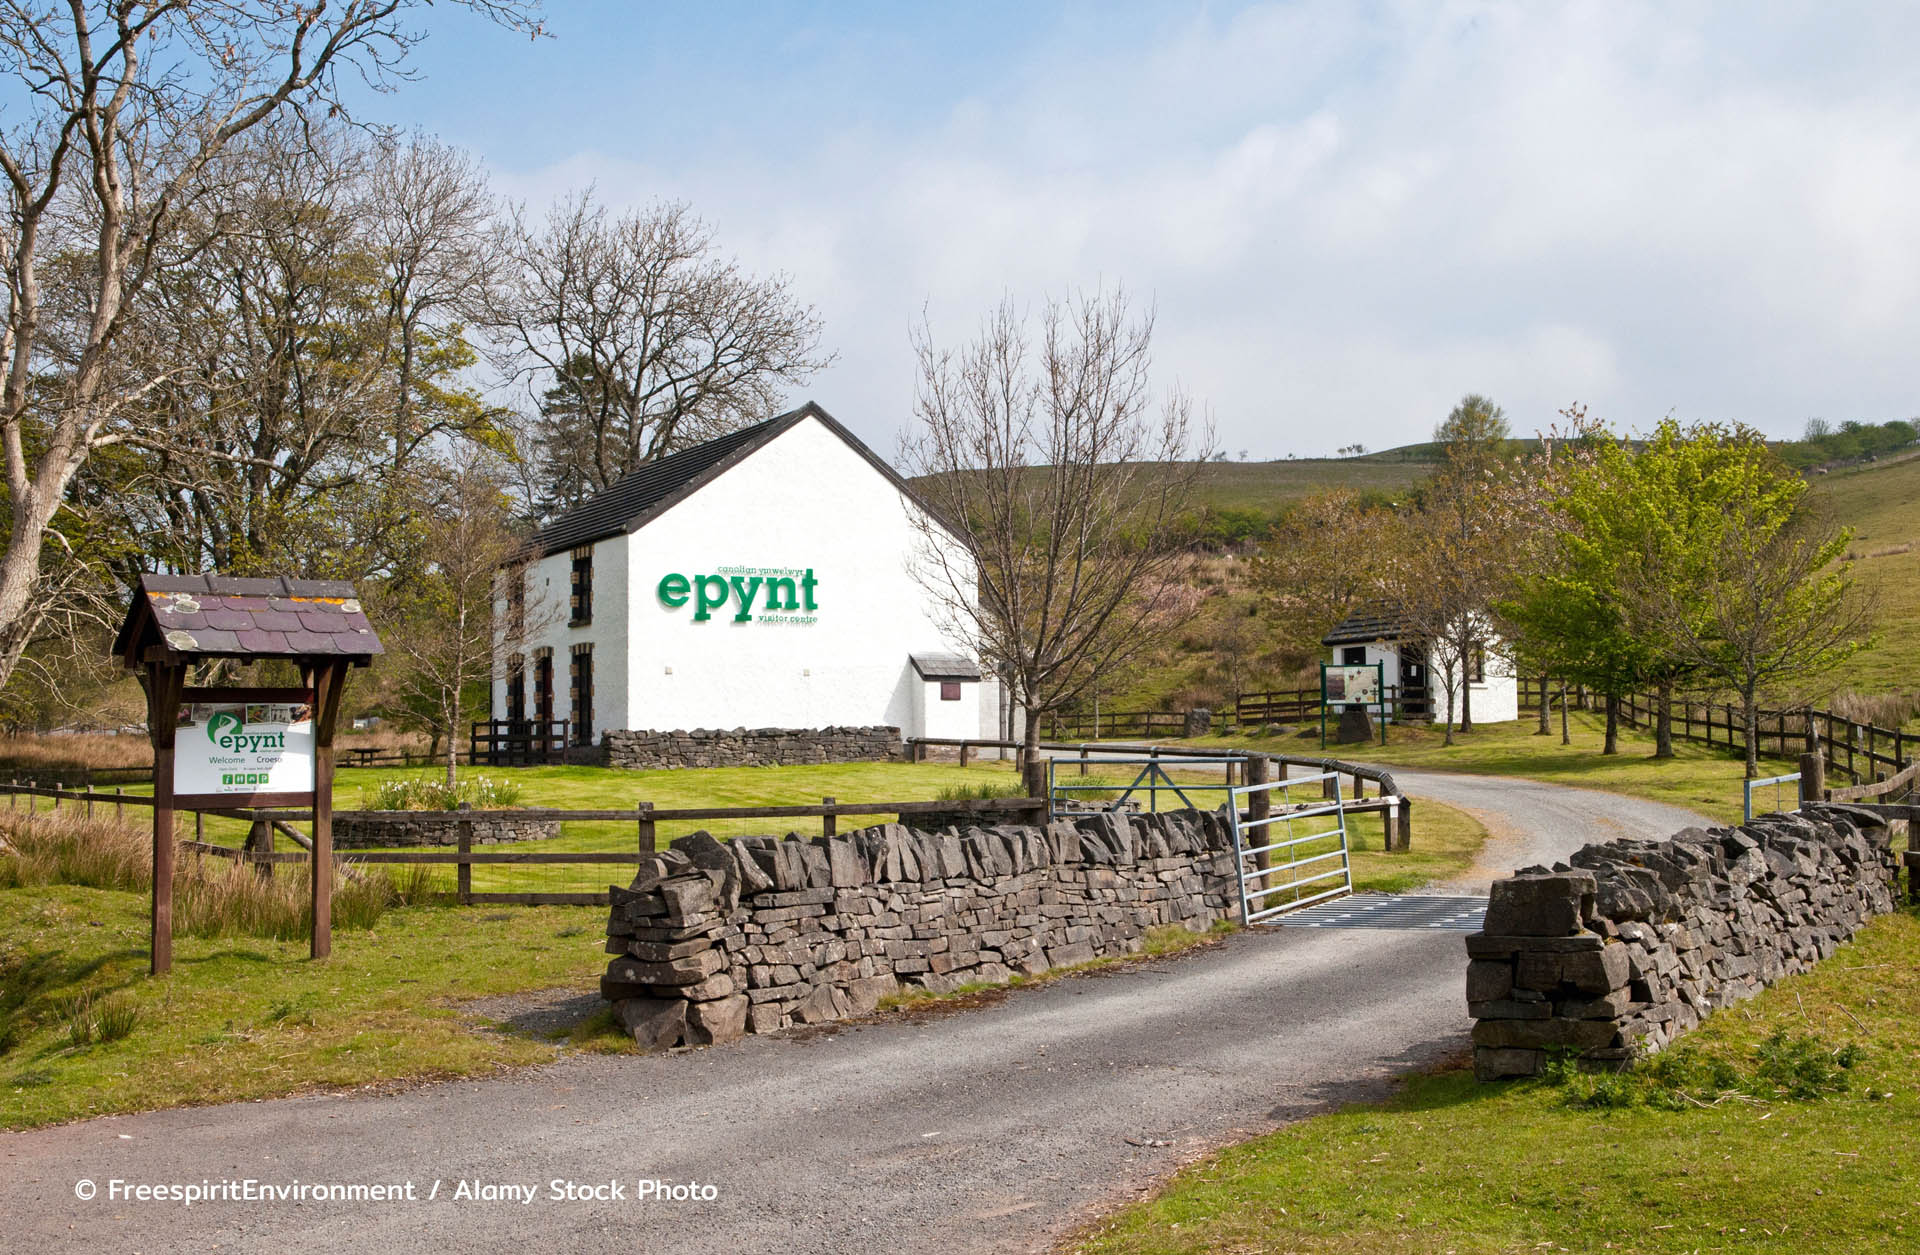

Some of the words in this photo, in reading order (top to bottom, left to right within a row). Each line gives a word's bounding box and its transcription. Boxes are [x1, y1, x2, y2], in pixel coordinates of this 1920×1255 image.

[658, 568, 819, 622] epynt
[758, 614, 789, 622] visitor
[219, 731, 285, 753] epynt
[208, 756, 246, 764] Welcome
